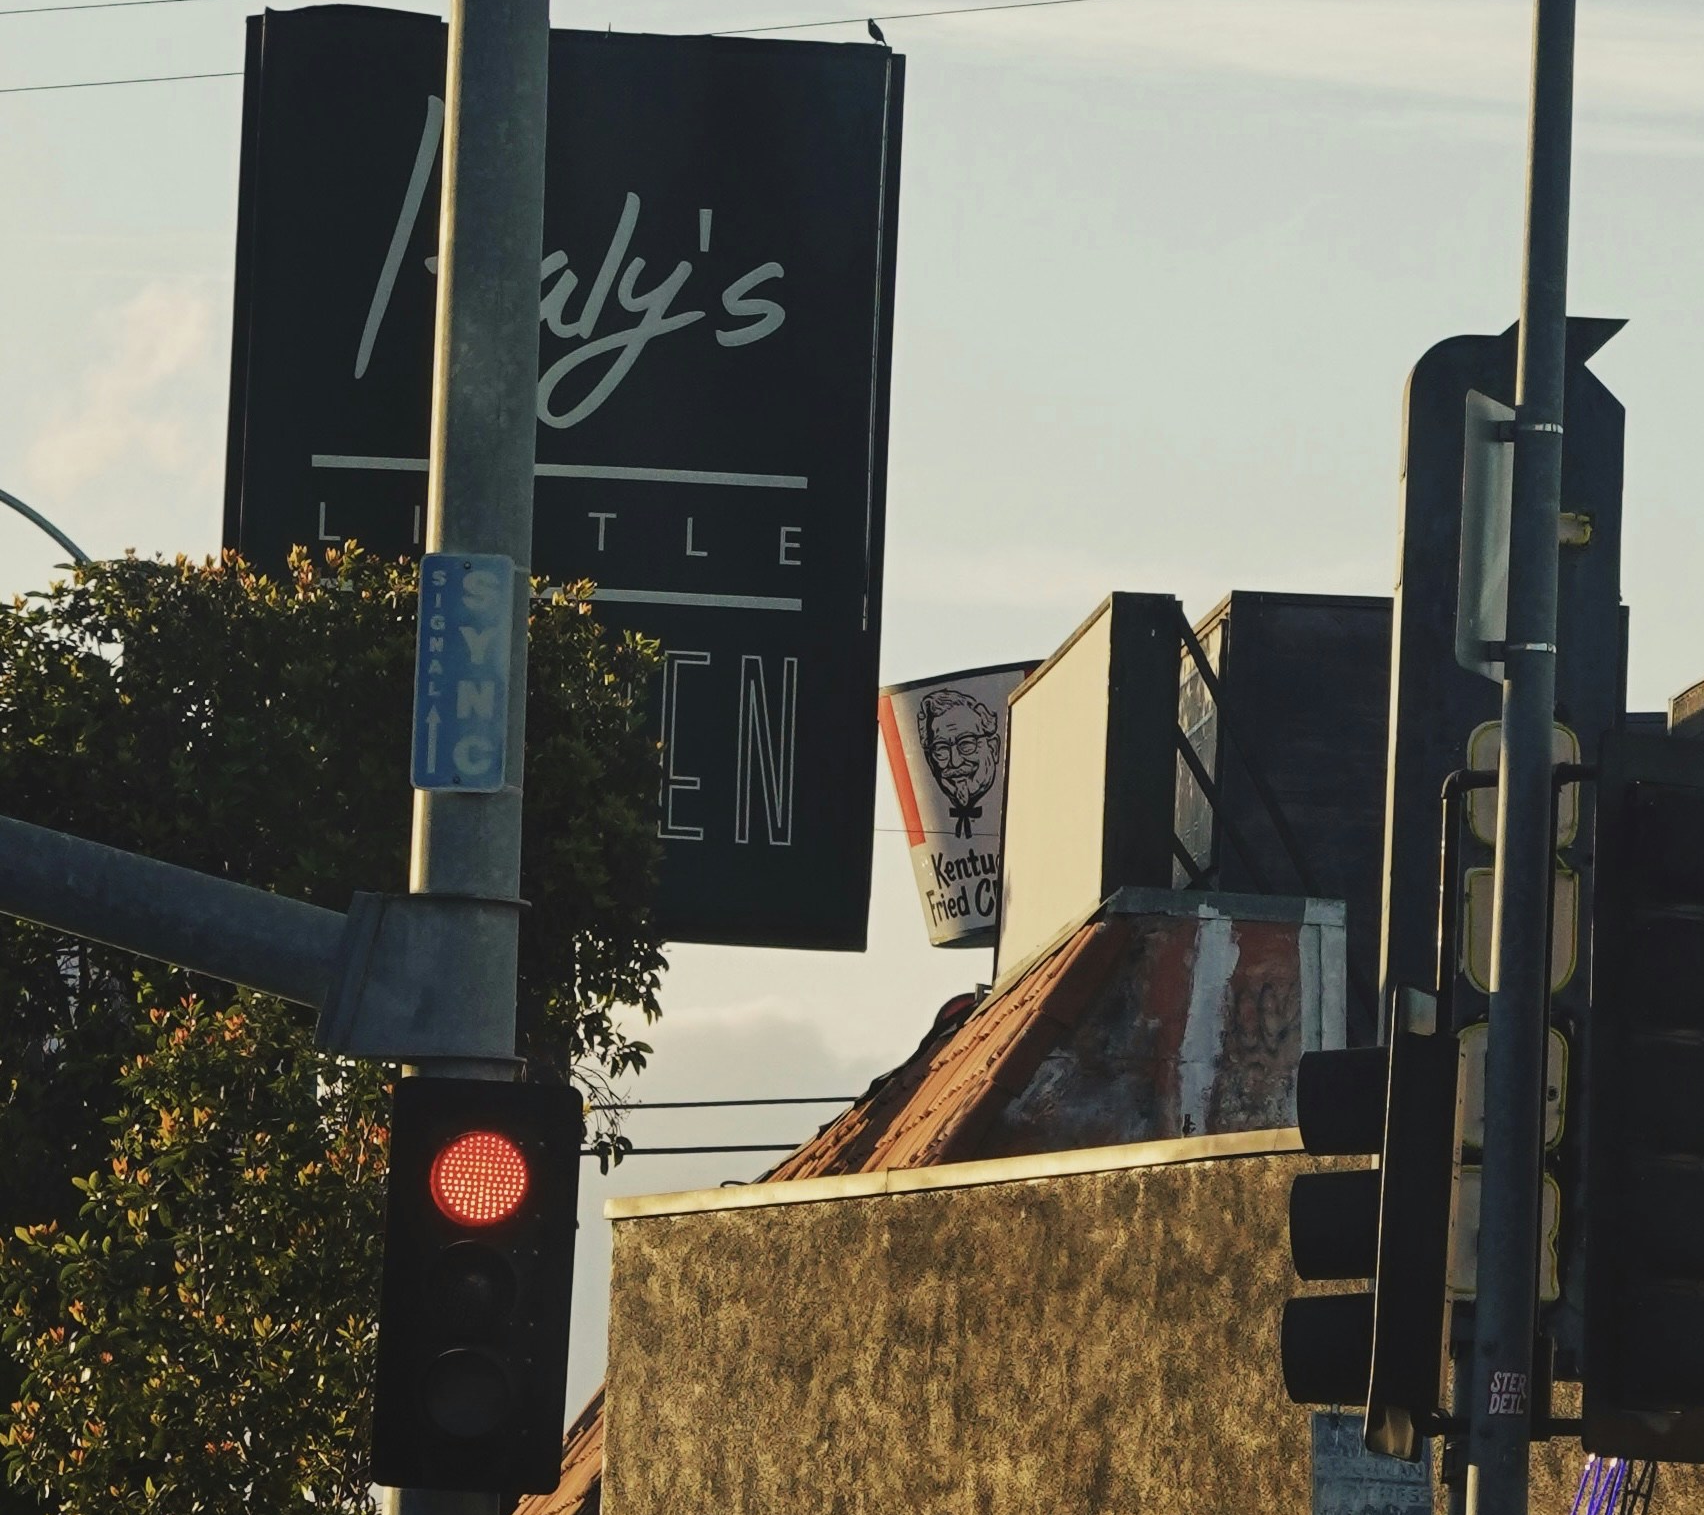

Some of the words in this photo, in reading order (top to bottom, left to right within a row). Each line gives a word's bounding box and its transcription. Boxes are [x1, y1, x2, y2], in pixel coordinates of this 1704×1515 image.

[354, 94, 786, 428] Ialy's
[318, 501, 801, 565] LITLE
[427, 569, 448, 697] SIGNAL
[454, 568, 501, 776] SYNC
[926, 886, 970, 927] Fried
[931, 848, 1000, 889] Kentu
